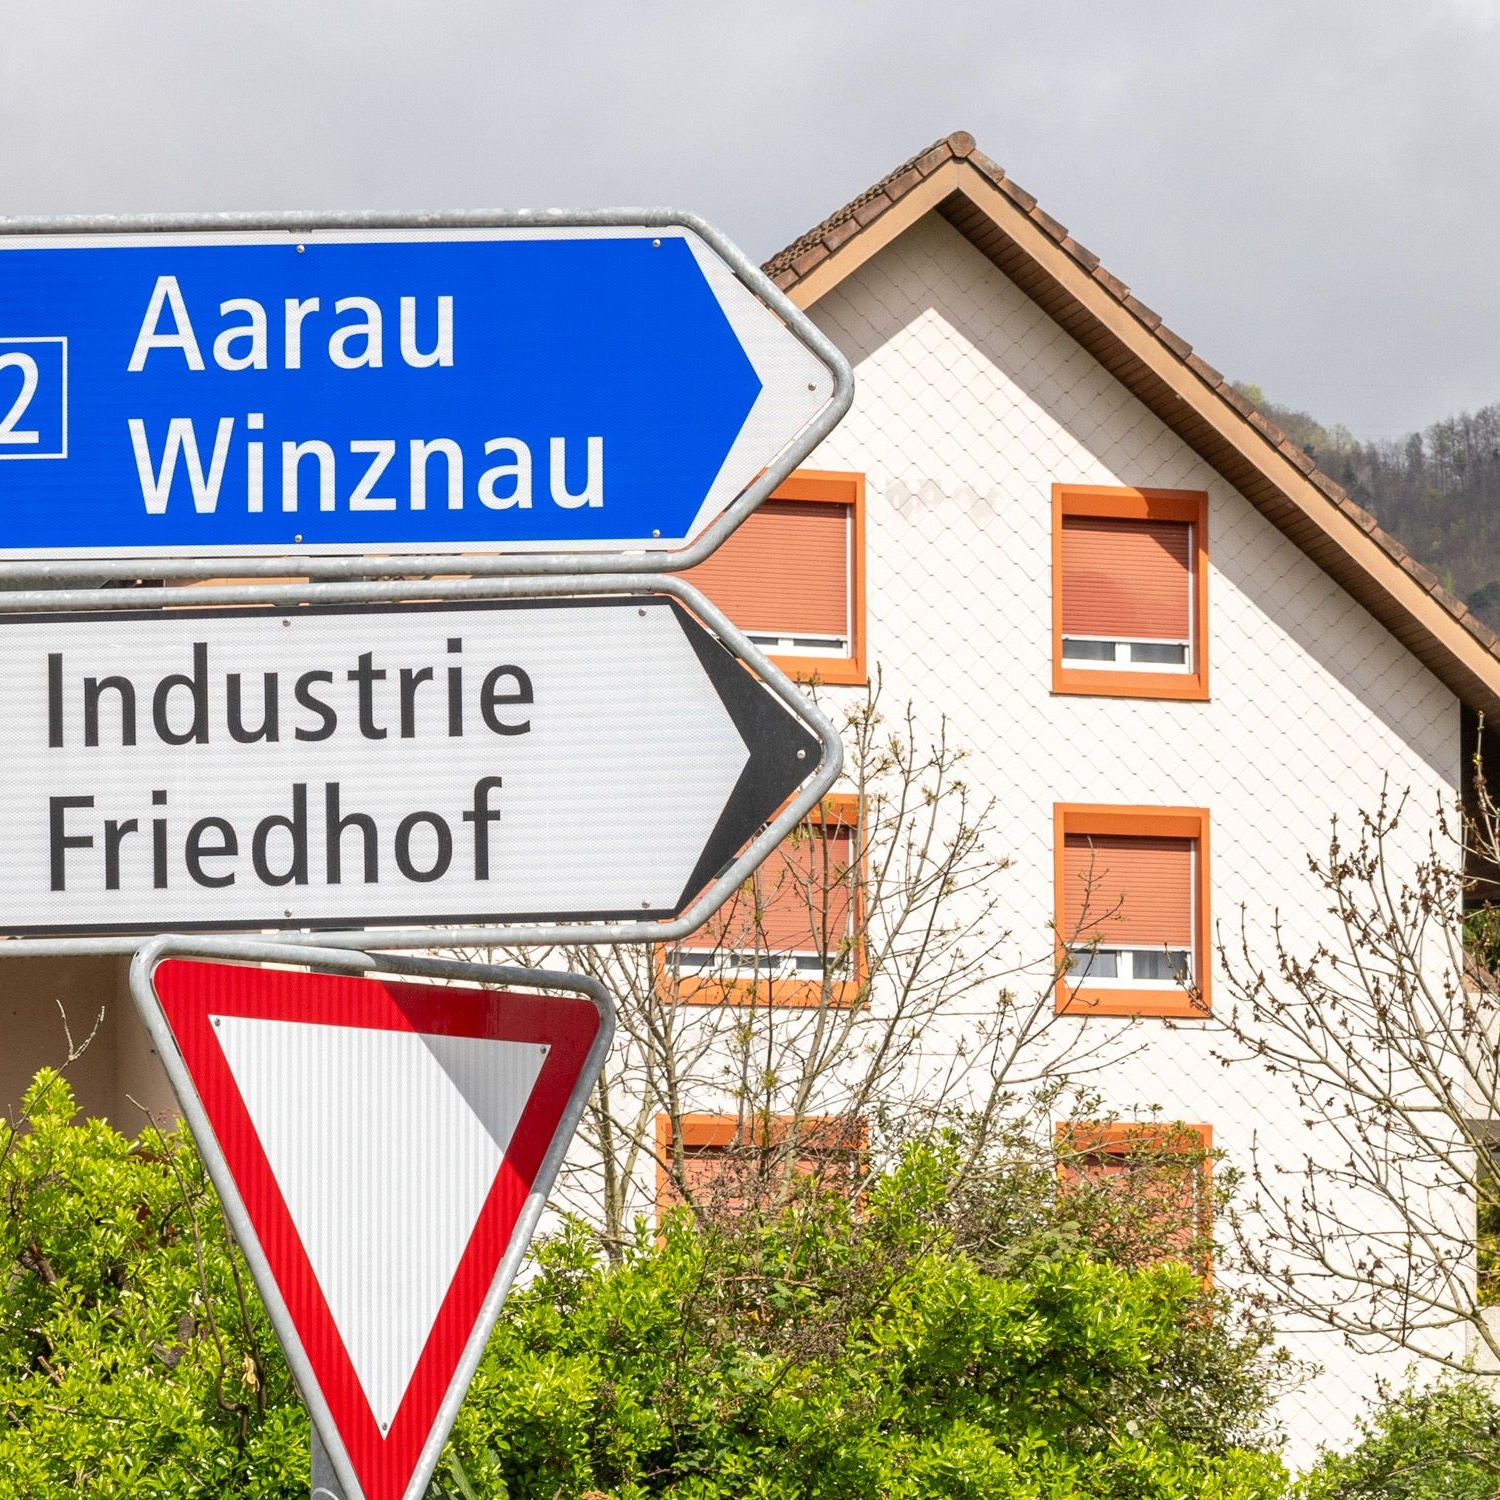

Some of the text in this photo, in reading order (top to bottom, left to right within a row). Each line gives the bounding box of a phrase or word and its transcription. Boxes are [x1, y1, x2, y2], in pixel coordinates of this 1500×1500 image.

[127, 275, 454, 372] Aarau
[127, 412, 604, 515] Winznau
[48, 637, 534, 748] Industrie
[49, 776, 503, 892] Friedhof
